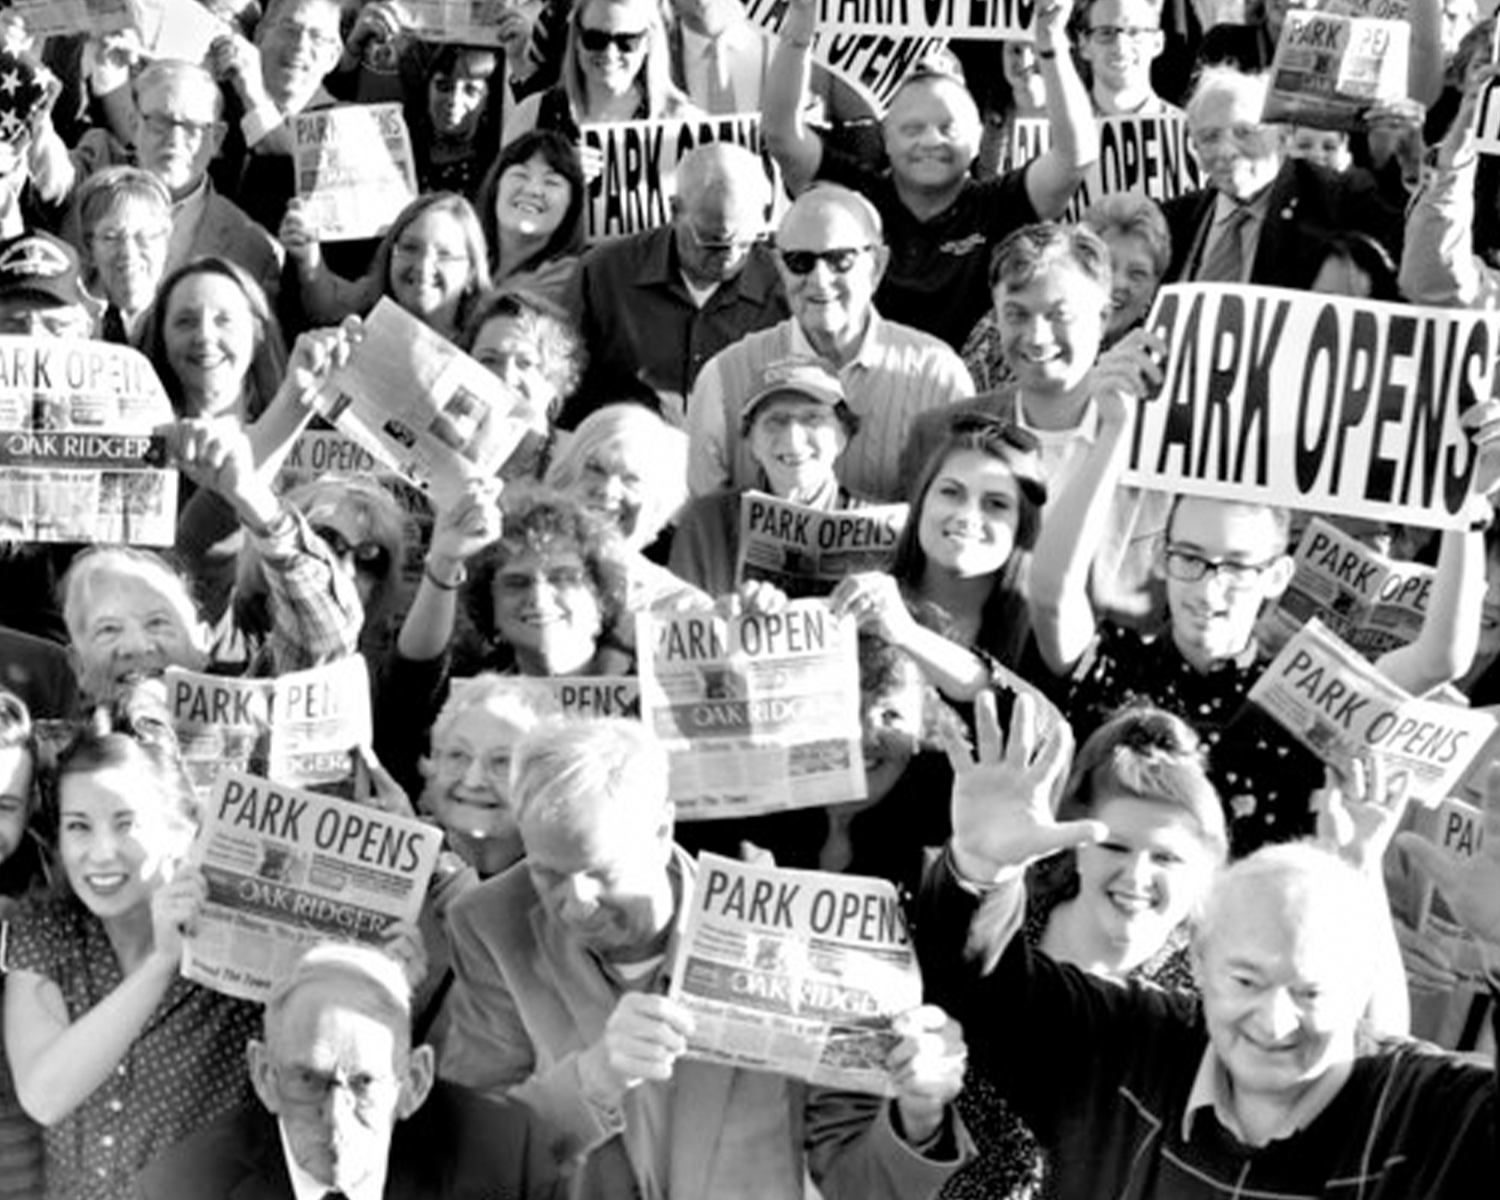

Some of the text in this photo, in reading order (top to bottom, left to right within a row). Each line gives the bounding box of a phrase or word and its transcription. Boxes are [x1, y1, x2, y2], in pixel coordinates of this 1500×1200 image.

[1129, 291, 1489, 515] PARK OPENS
[7, 434, 152, 460] OAK RIDGER
[751, 502, 896, 550] PARK OPENS
[1305, 532, 1434, 612] PARK OPE
[740, 609, 827, 656] OPEN
[173, 680, 254, 725] PARK
[561, 684, 632, 718] PENS
[1281, 650, 1470, 764] PARK OPENS
[217, 779, 426, 873] PARK OPENS
[1443, 812, 1484, 857] PA
[239, 878, 288, 911] OAK
[702, 870, 801, 929] PARK
